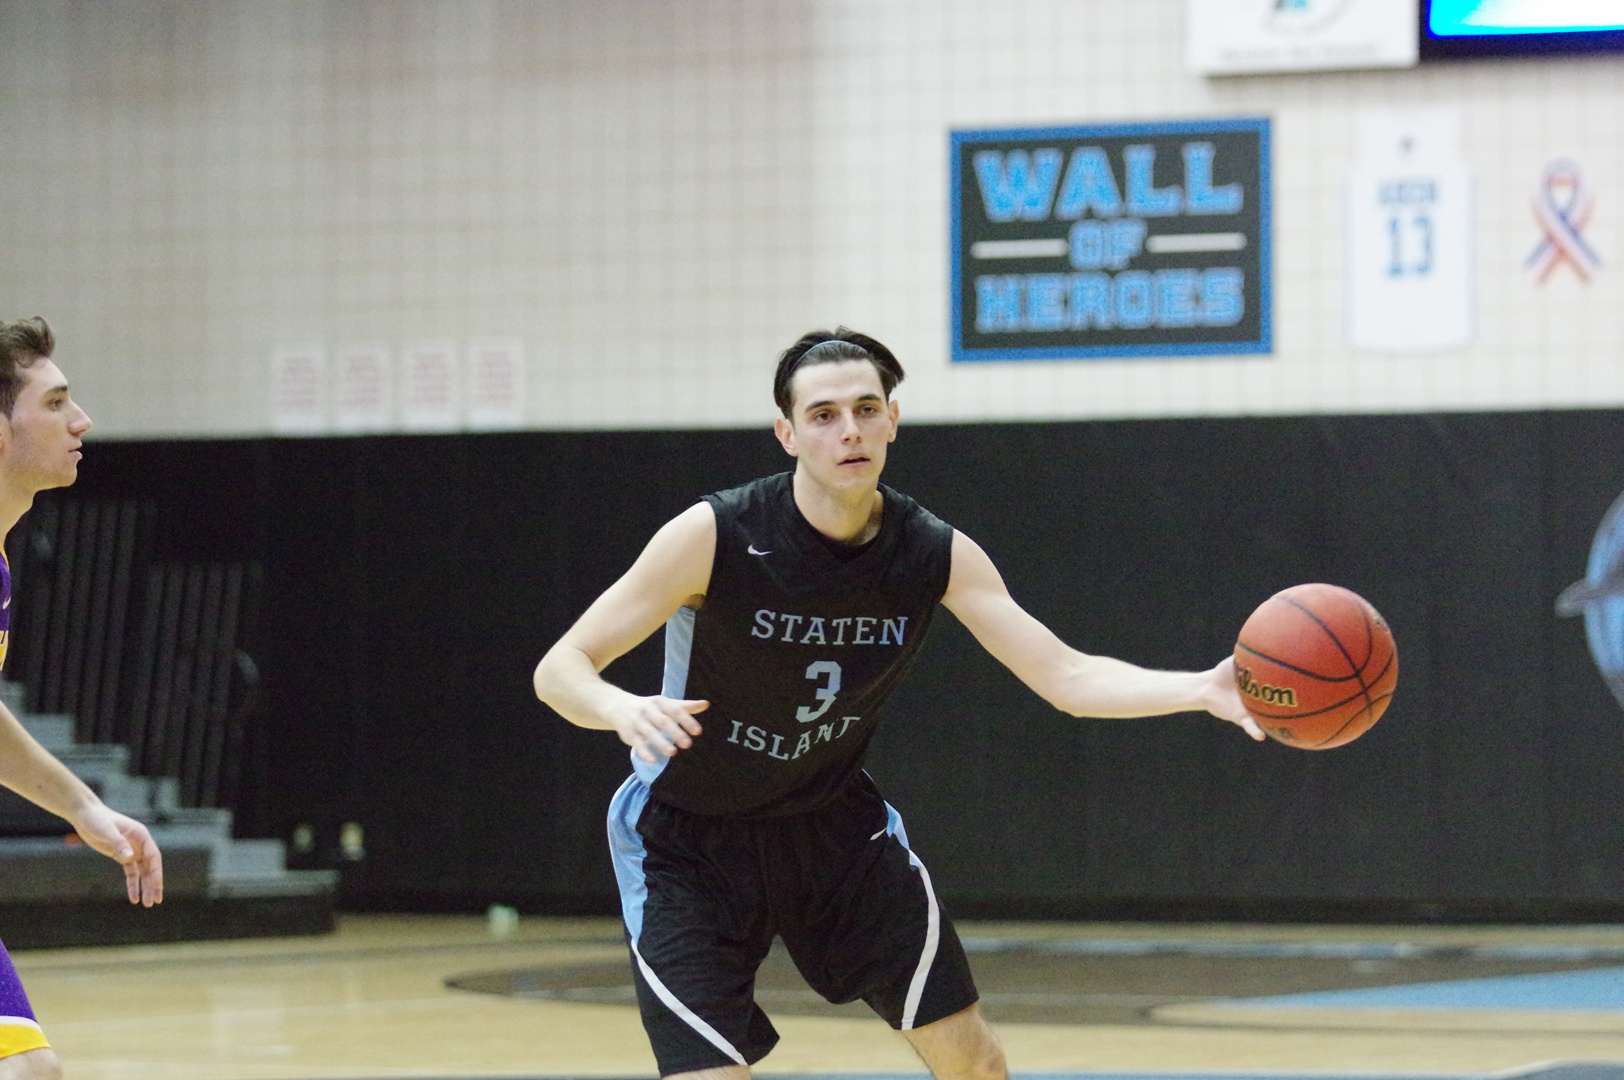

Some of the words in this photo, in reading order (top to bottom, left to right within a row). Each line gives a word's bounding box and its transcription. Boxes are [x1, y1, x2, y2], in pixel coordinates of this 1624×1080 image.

[973, 141, 1244, 222] WALL
[1069, 217, 1147, 270] OF
[975, 266, 1245, 333] HEROES
[751, 609, 908, 645] STATEN
[796, 660, 842, 723] 3
